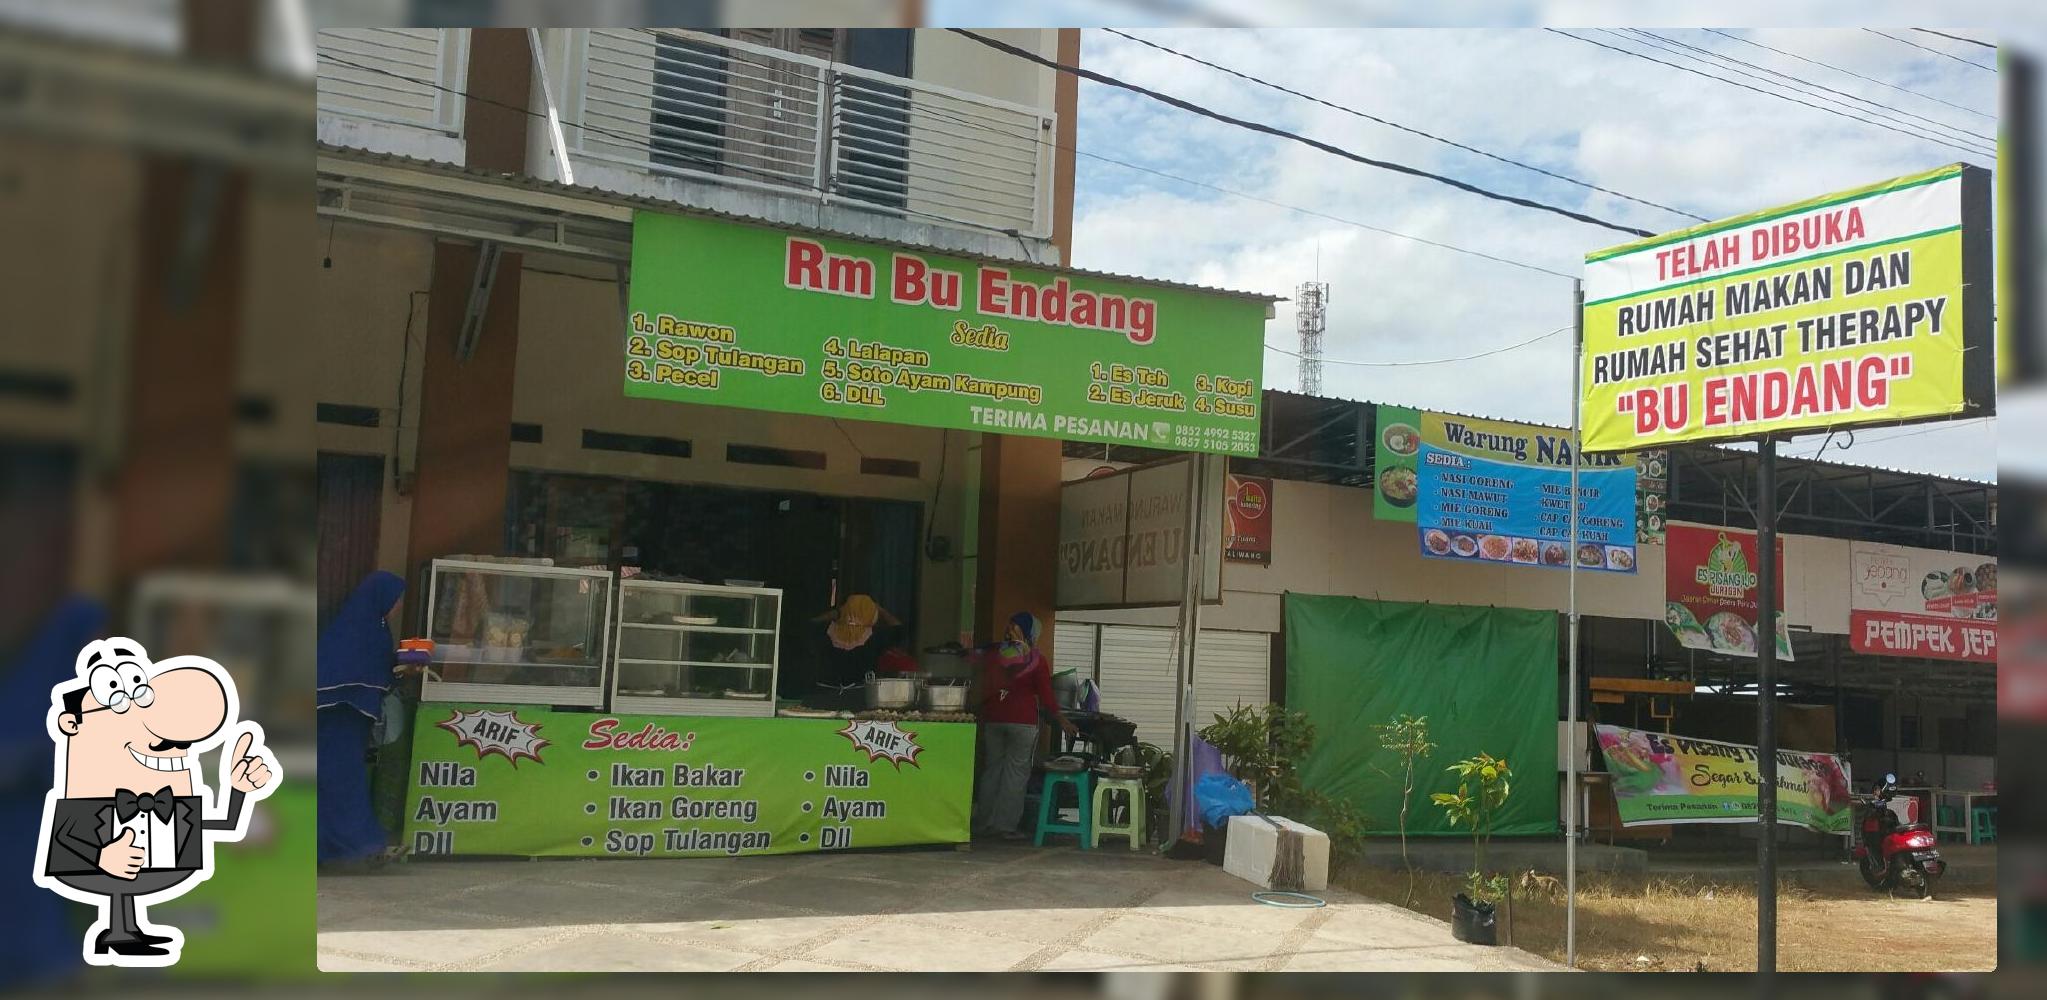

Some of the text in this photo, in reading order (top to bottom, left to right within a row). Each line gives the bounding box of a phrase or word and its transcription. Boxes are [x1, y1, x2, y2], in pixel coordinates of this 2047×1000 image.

[1656, 206, 1865, 281] TELAH DIBUKA
[785, 236, 1157, 345] Rm Bu Endang
[1617, 251, 1910, 337] RUMAH MAKAN DAN
[632, 313, 736, 344] 1. Rawon
[950, 320, 1009, 352] Sedia
[1594, 297, 1948, 384] RUMAH SEHAT THERAPY
[627, 337, 805, 376] 2. Sop Tulangan
[823, 337, 930, 370] 4. Lalapan
[627, 361, 720, 390] 3. Pecel
[822, 361, 1042, 406] 5. Soto Ayam Kampung
[1089, 362, 1170, 389] 1. Es Teh
[1195, 375, 1254, 400] 3. Kopi
[821, 383, 886, 407] 6. DLL
[1087, 385, 1186, 412] 2. Es Jeruk
[1617, 356, 1911, 435] "BU ENDANG"
[1194, 398, 1256, 419] 4. Susu
[970, 405, 1148, 441] TERIMA PESANAN
[1175, 425, 1200, 436] 0852
[1443, 421, 1528, 461] Warung
[1425, 452, 1464, 467] SEDIA
[1441, 473, 1515, 489] NASI GORENG
[1542, 484, 1601, 498] MIE BNCIR
[1441, 488, 1508, 503] NASI MAWUT
[1441, 503, 1509, 518] MIE GORENG
[1581, 516, 1624, 528] GORENG
[1441, 518, 1493, 531] MIE KUAH
[1582, 530, 1609, 541] KUAH
[1864, 620, 1997, 658] PEMPEK JEP
[472, 718, 520, 745] ARIF
[583, 718, 695, 752] Sedia:
[863, 726, 902, 750] ARIF
[419, 761, 476, 787] Nila
[610, 763, 743, 788] Ikan Bakar
[824, 765, 869, 787] Nila
[1691, 764, 1742, 788] Segar
[415, 796, 497, 825] Ayam
[608, 797, 758, 823] Ikan Goreng
[822, 798, 886, 821] Ayam
[605, 829, 771, 855] Sop Tulangan
